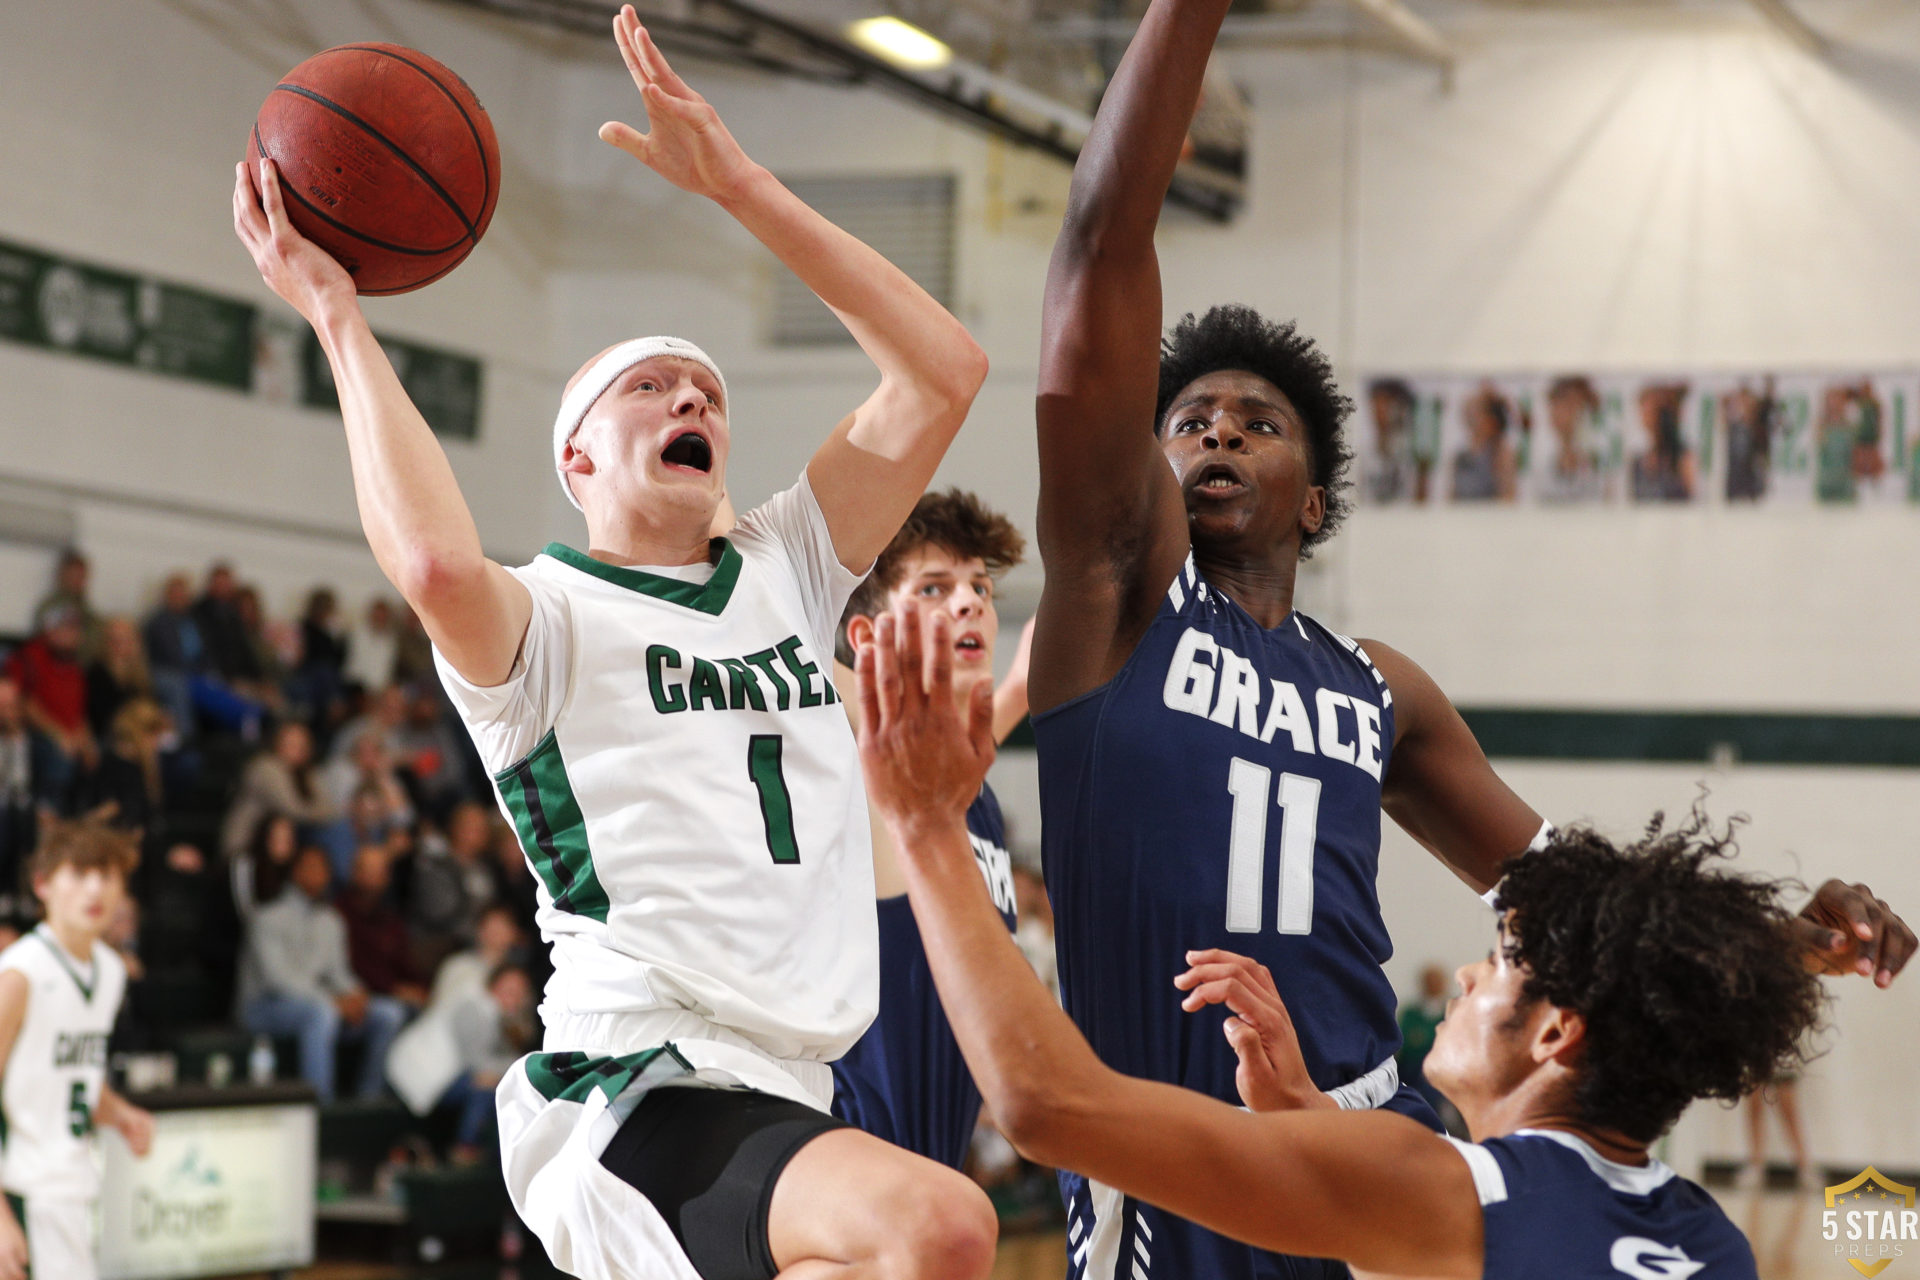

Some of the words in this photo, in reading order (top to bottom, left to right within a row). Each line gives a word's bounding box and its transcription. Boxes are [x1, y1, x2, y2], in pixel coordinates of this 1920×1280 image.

[1163, 627, 1383, 784] GRACE
[747, 734, 801, 865] 1
[1225, 756, 1322, 936] 11
[69, 1080, 92, 1138] 5
